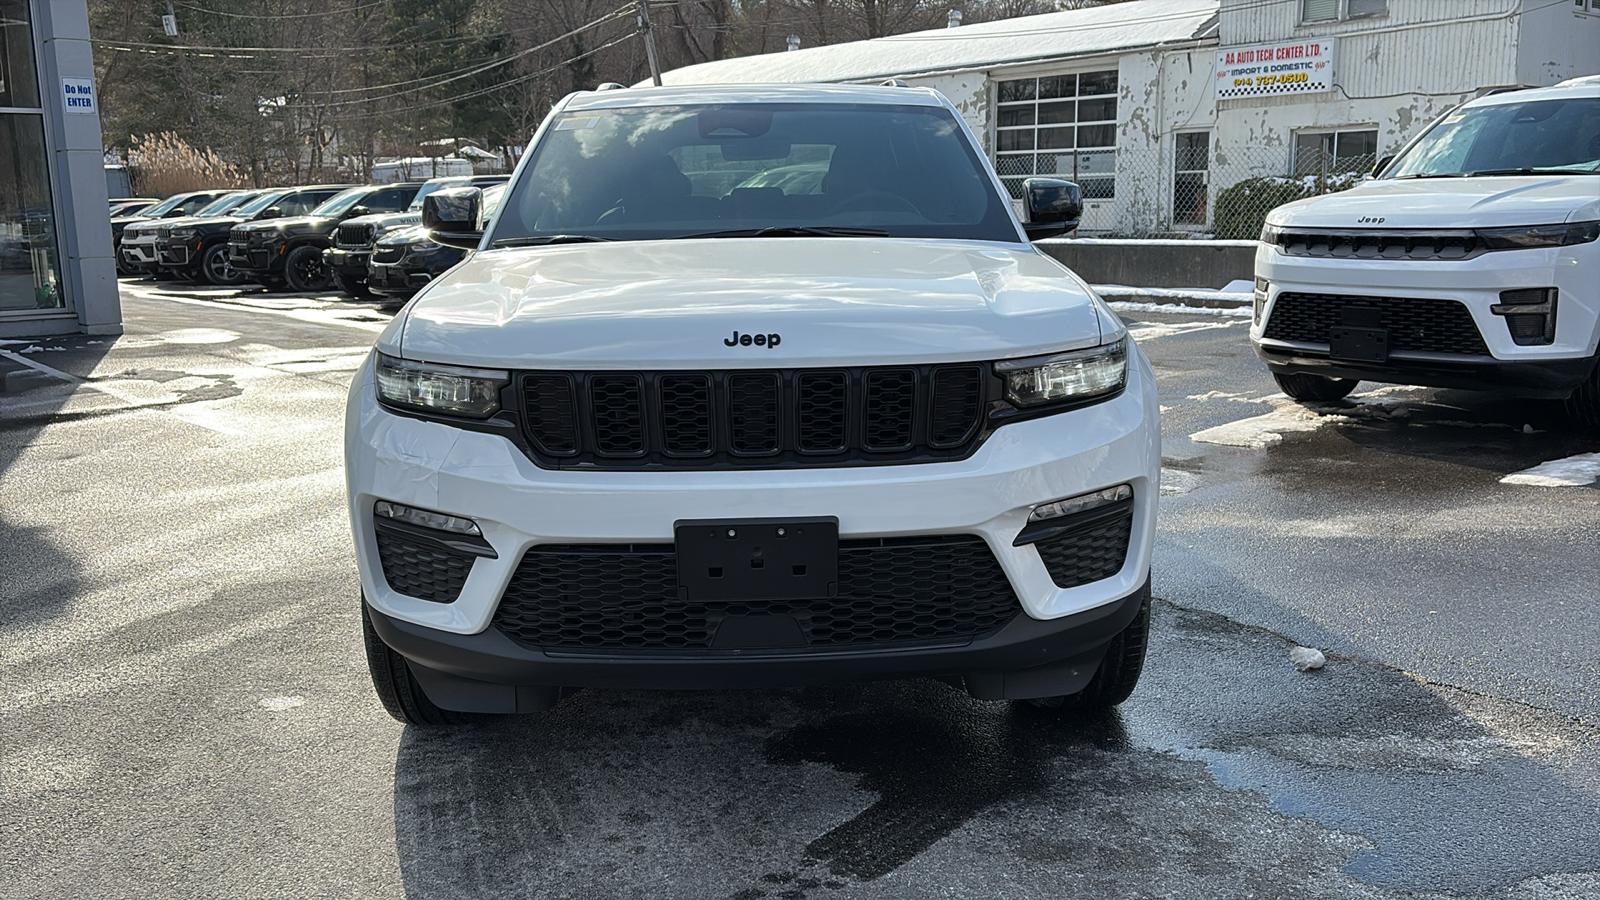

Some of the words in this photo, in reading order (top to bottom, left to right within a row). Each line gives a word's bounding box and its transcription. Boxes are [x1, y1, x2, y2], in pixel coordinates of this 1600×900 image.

[1225, 53, 1235, 65] AA
[1236, 50, 1254, 64] AUTO
[1255, 48, 1274, 62] TECH
[1276, 45, 1304, 60] CENTER
[1305, 44, 1322, 57] LTD.
[1231, 66, 1262, 76] IMPORT
[1263, 65, 1270, 73] &
[1270, 61, 1313, 73] DOMESTIC
[1256, 72, 1309, 86] 737-0500
[65, 84, 76, 94] Do
[77, 84, 92, 95] Not
[67, 97, 92, 107] ENTER
[1357, 215, 1386, 225] Jeep
[723, 330, 782, 349] Jeep
